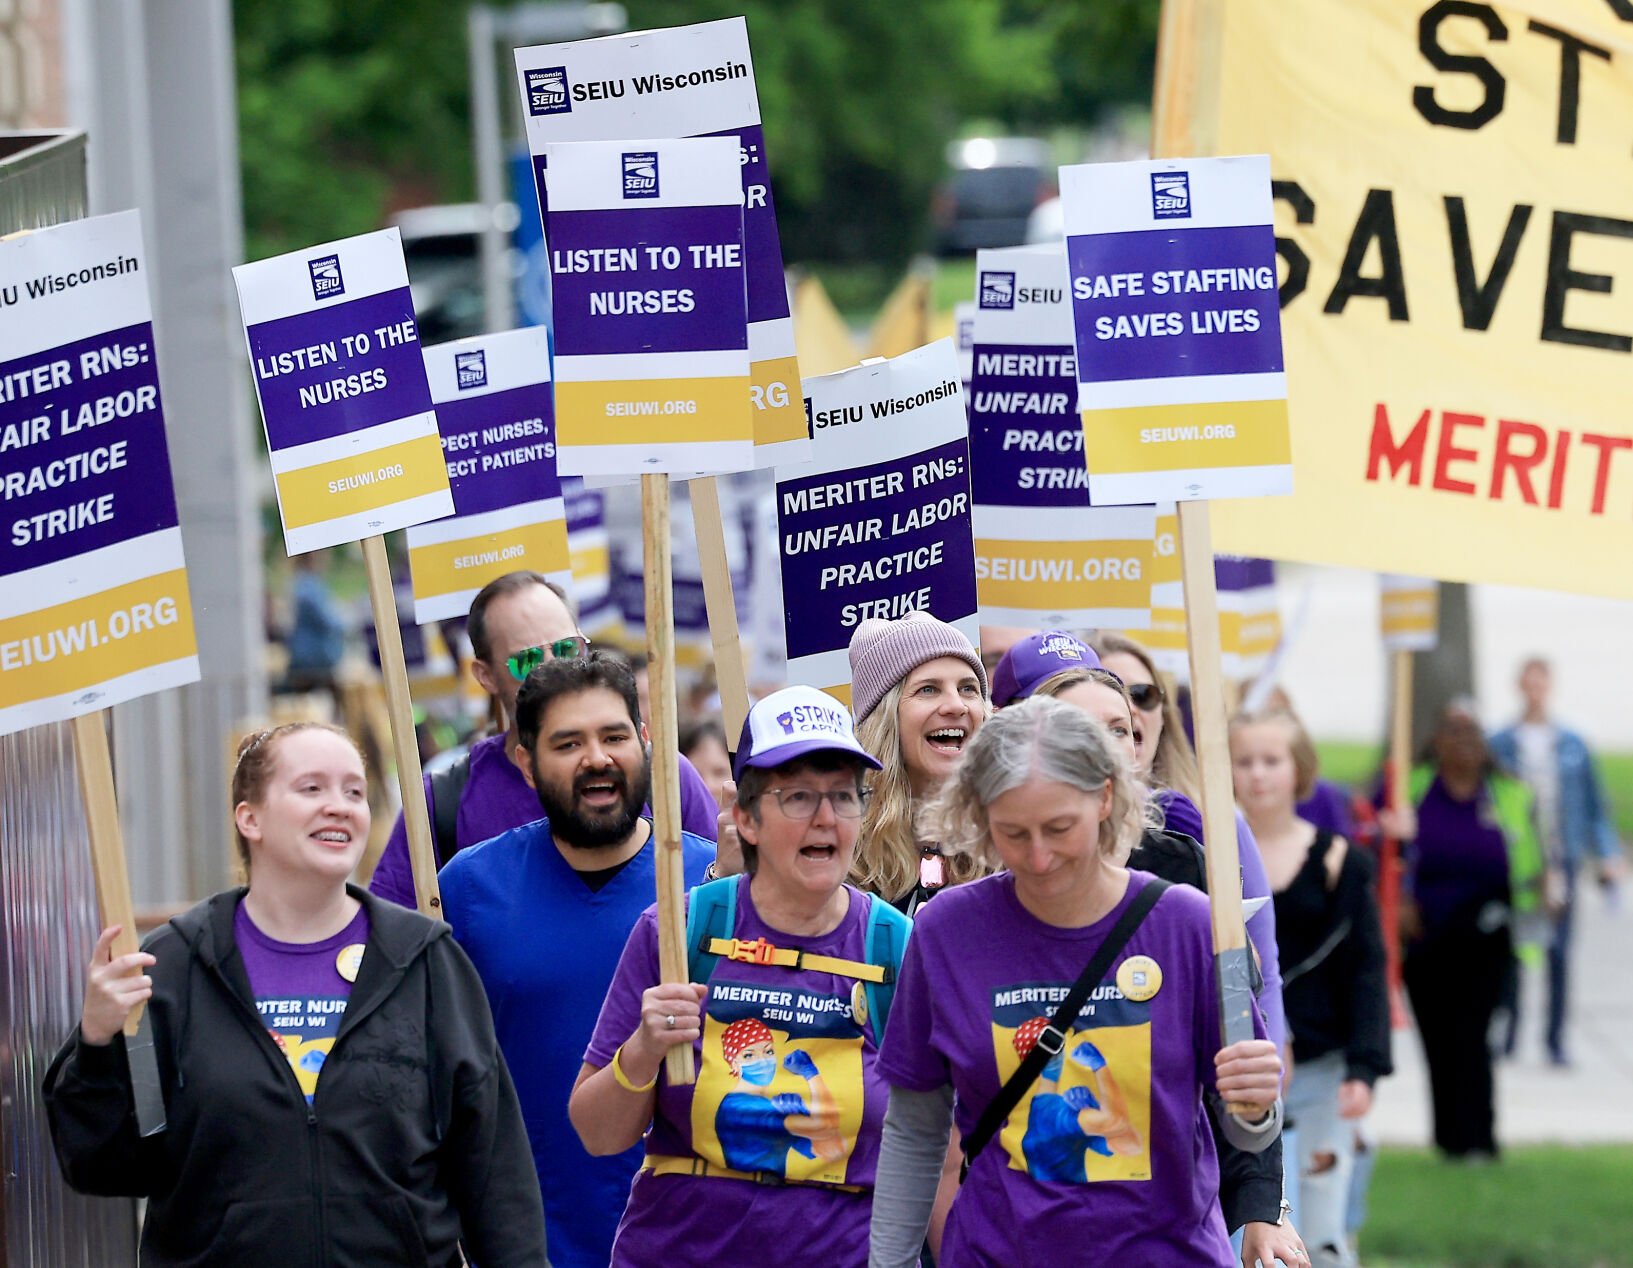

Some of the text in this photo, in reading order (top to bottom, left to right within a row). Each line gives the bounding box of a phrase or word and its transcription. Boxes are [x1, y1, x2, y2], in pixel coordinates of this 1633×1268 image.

[529, 71, 563, 80] Wisconsin
[572, 61, 747, 102] SEIU Wisconsin
[532, 93, 565, 106] SEIU
[625, 178, 656, 189] SEIU
[1155, 198, 1187, 210] SEIU
[554, 244, 741, 274] LISTEN TO THE
[26, 256, 138, 299] Wisconsin
[316, 277, 340, 291] SEIU
[1074, 267, 1274, 300] SAFE STAFFING
[589, 289, 695, 315] NURSES
[1018, 288, 1062, 304] SEIU
[1095, 309, 1261, 340] SAVES LIVES
[258, 320, 417, 379] LISTEN TO THE
[0, 344, 149, 403] ITER RNs:
[299, 368, 388, 409] NURSES
[974, 391, 1069, 415] UNFAIR
[0, 385, 156, 453] AIR LABOR
[605, 400, 697, 416] SEIUWI.ORG
[815, 405, 863, 429] SEIU
[870, 380, 957, 419] Wisconsin
[483, 418, 549, 445] NURSES,
[1140, 424, 1236, 444] SEIUWI.ORG
[482, 443, 556, 472] PATIENTS
[328, 463, 404, 494] SEIUWI.ORG
[783, 456, 964, 516] MERITER RNs:
[11, 493, 114, 546] STRIKE
[785, 492, 967, 555] UNFAIR LABOR
[454, 544, 525, 569] SEIUWI.ORG
[820, 541, 944, 591] PRACTICE
[976, 557, 1142, 582] SEIUWI.ORG
[840, 587, 931, 627] STRIKE
[0, 596, 178, 671] EIUWI.ORG
[713, 986, 793, 1006] MERITER
[272, 1016, 326, 1027] SEIU WI
[762, 1008, 814, 1024] SEIU WI
